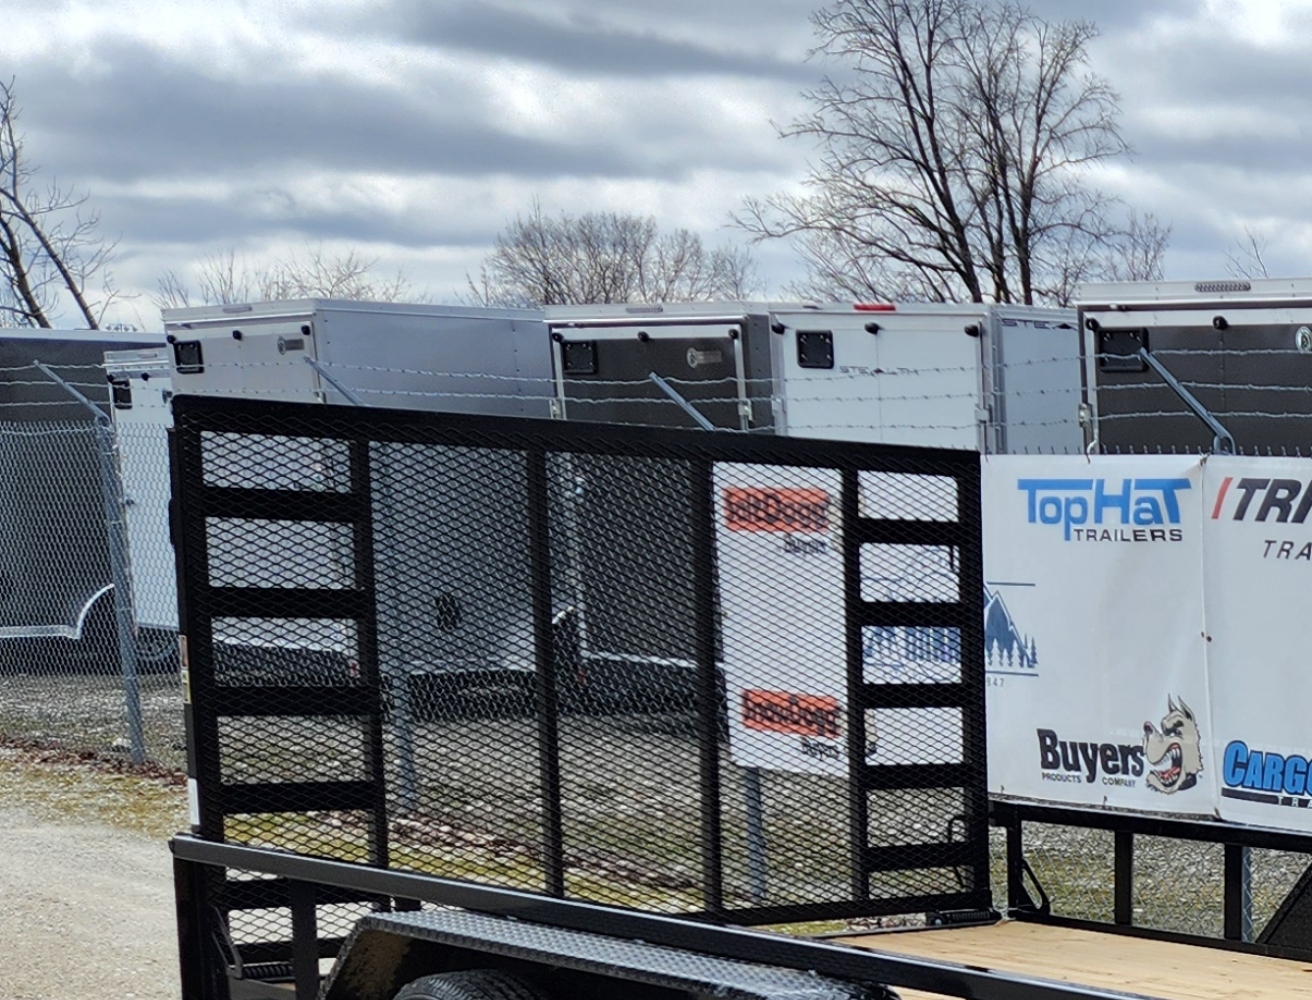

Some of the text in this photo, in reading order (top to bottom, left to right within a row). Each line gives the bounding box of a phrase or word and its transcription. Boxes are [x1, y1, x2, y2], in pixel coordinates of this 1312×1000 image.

[1073, 528, 1183, 542] TRAILERS
[1037, 728, 1146, 783] Buyers
[1041, 772, 1136, 788] PRODUCTS COMPANY
